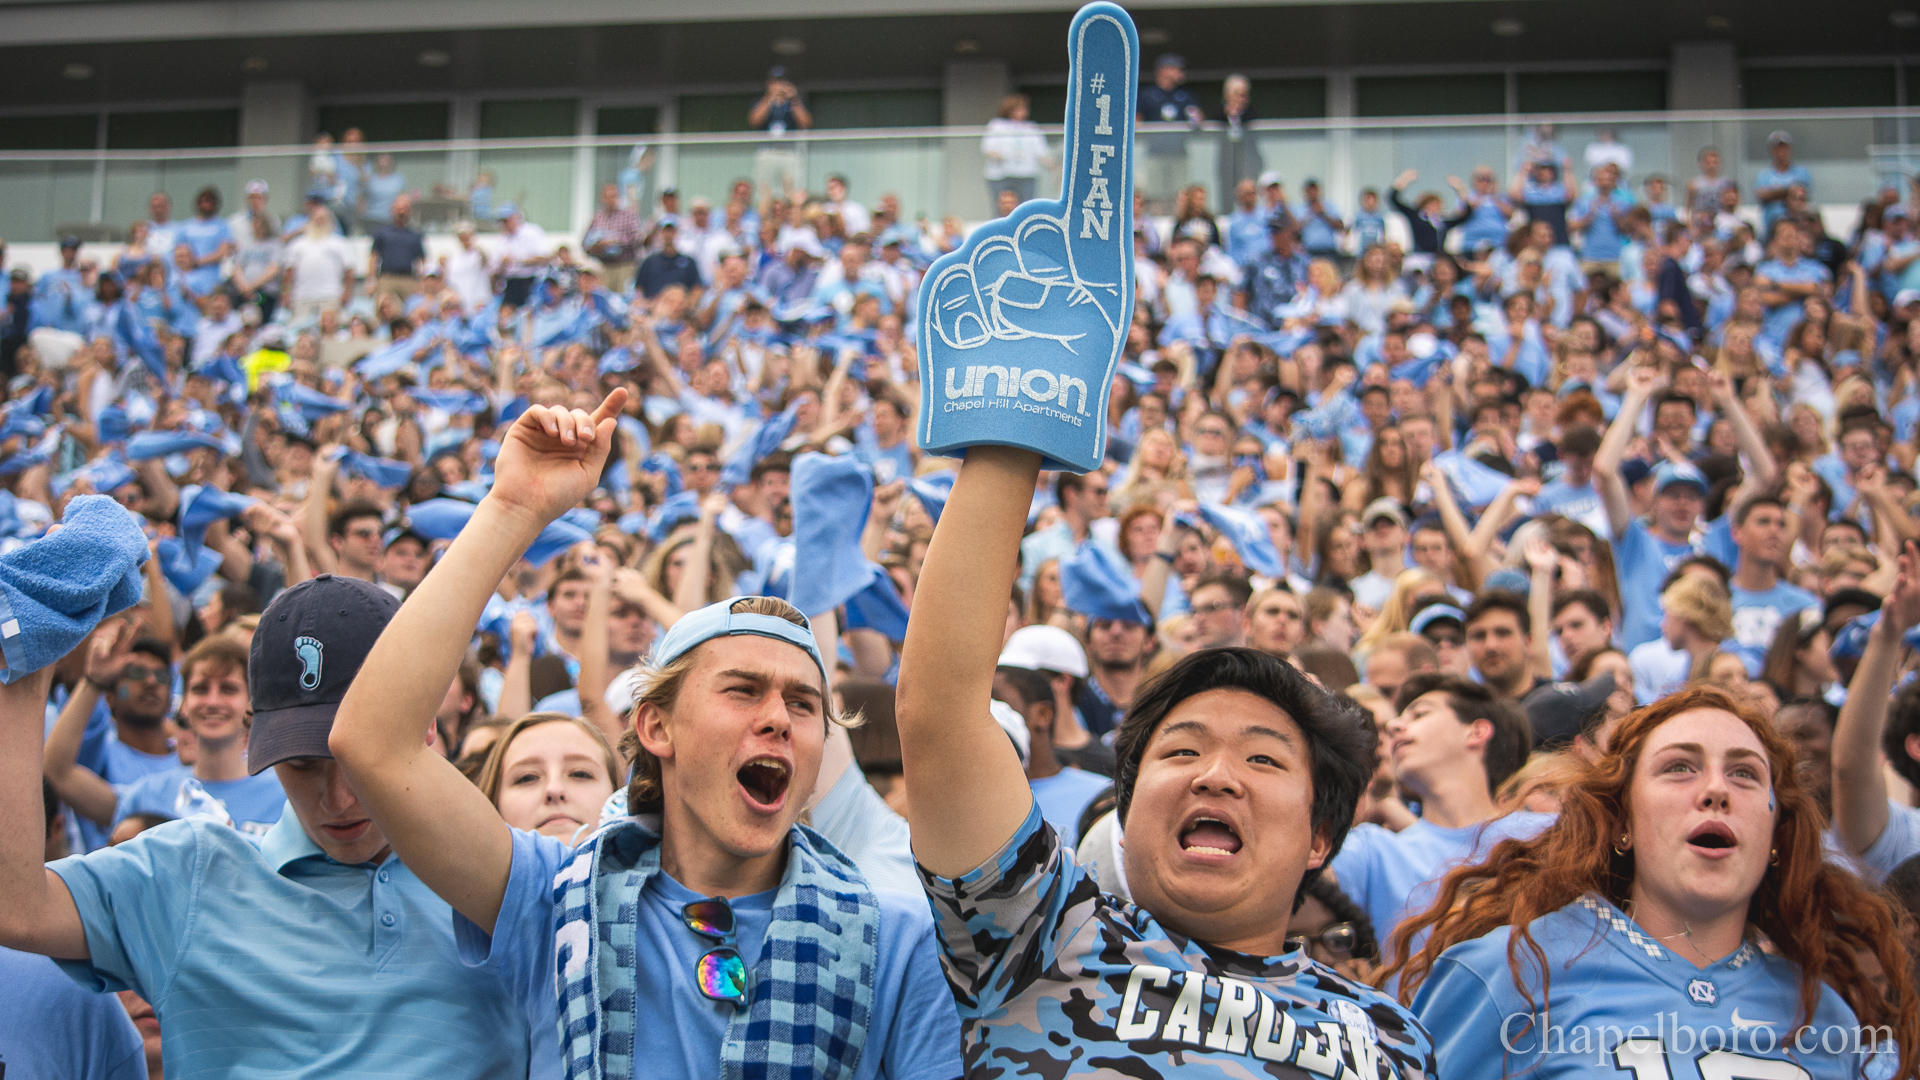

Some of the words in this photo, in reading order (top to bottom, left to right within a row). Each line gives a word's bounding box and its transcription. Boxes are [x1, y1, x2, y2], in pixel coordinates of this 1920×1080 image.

[1080, 144, 1115, 241] FAN
[944, 398, 985, 413] Chapel
[988, 398, 1010, 409] Hill
[1012, 400, 1082, 427] Apartments
[945, 365, 1088, 415] union
